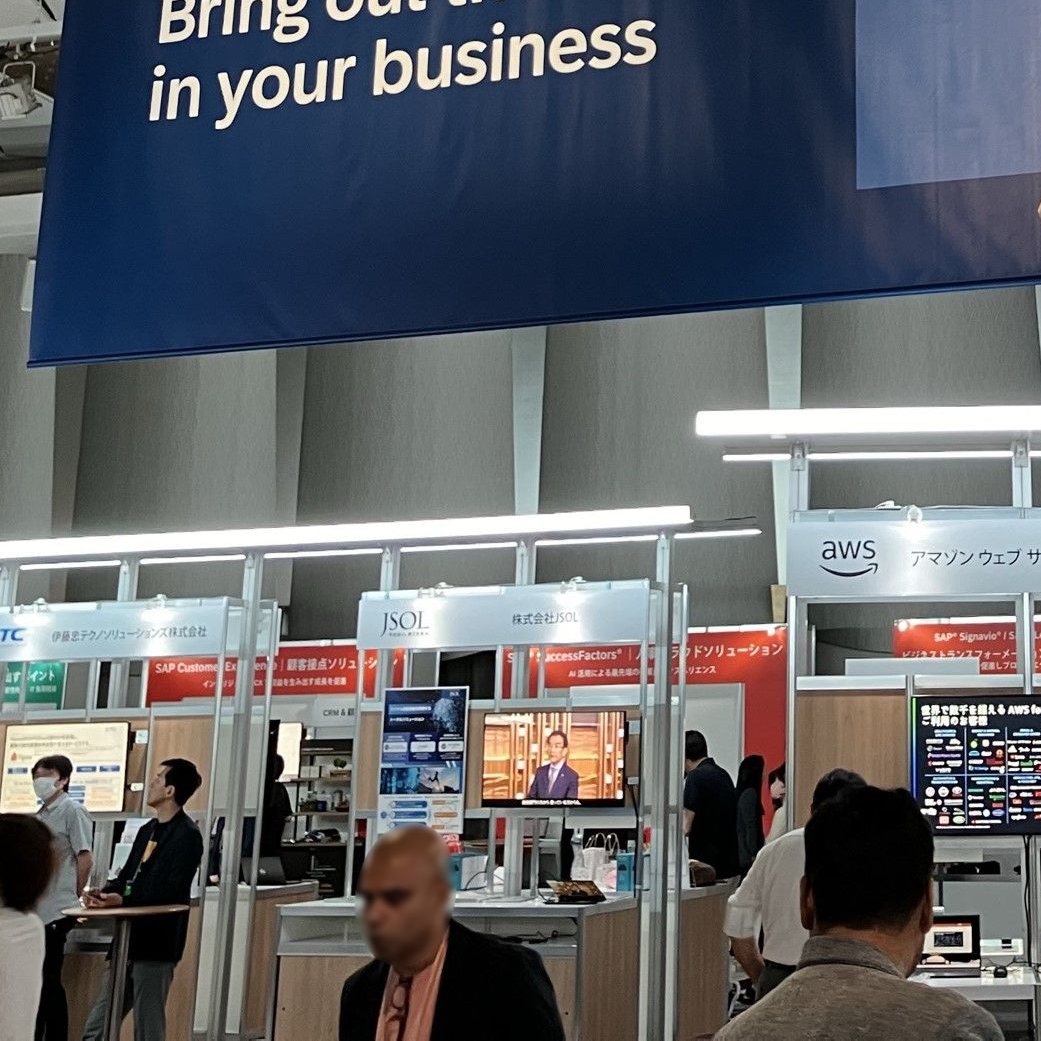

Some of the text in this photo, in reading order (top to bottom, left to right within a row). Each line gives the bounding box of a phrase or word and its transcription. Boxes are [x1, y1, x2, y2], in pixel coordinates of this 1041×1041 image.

[148, 21, 657, 129] in your business
[822, 540, 876, 560] aws
[380, 610, 430, 637] JSOL
[512, 611, 579, 626] 株式会社JSOL
[0, 627, 26, 642] TC
[52, 625, 207, 643] 伊藤忠テクノソリューションズ株式会社
[155, 662, 176, 674] SAP
[177, 661, 221, 673] Custome
[1007, 704, 1030, 715] AWS
